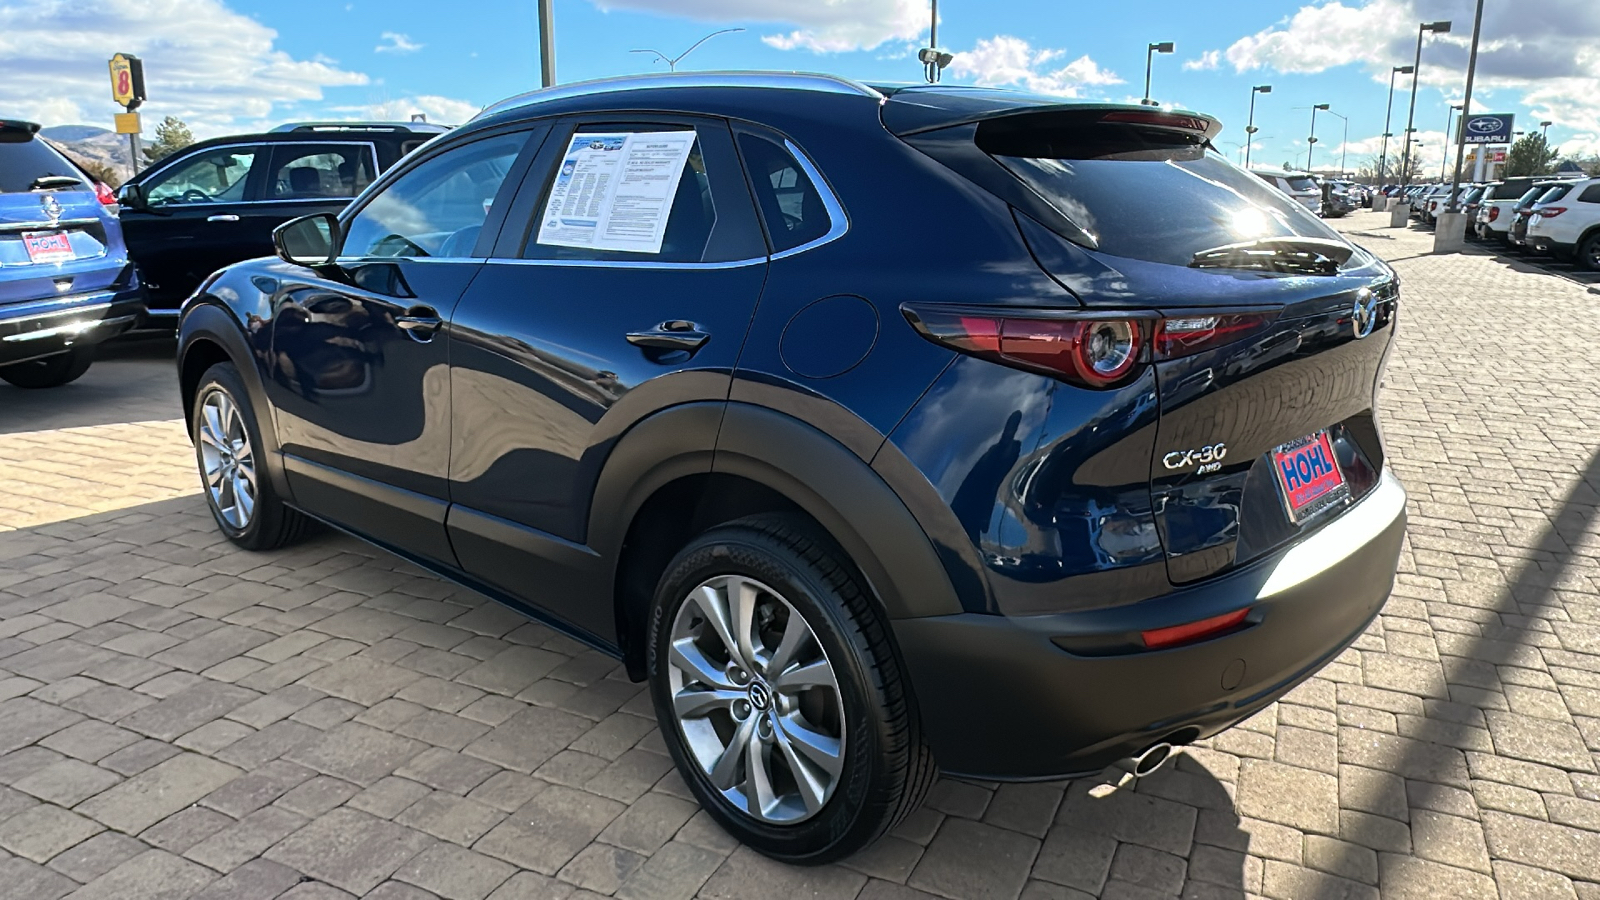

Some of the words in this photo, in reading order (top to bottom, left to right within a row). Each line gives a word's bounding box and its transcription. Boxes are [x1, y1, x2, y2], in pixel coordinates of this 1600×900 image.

[118, 70, 130, 96] 8
[31, 237, 66, 249] HOHL
[1163, 443, 1227, 470] CX-30
[1197, 461, 1222, 475] AWD
[1281, 444, 1333, 492] HOHL
[649, 605, 662, 676] KUMHO
